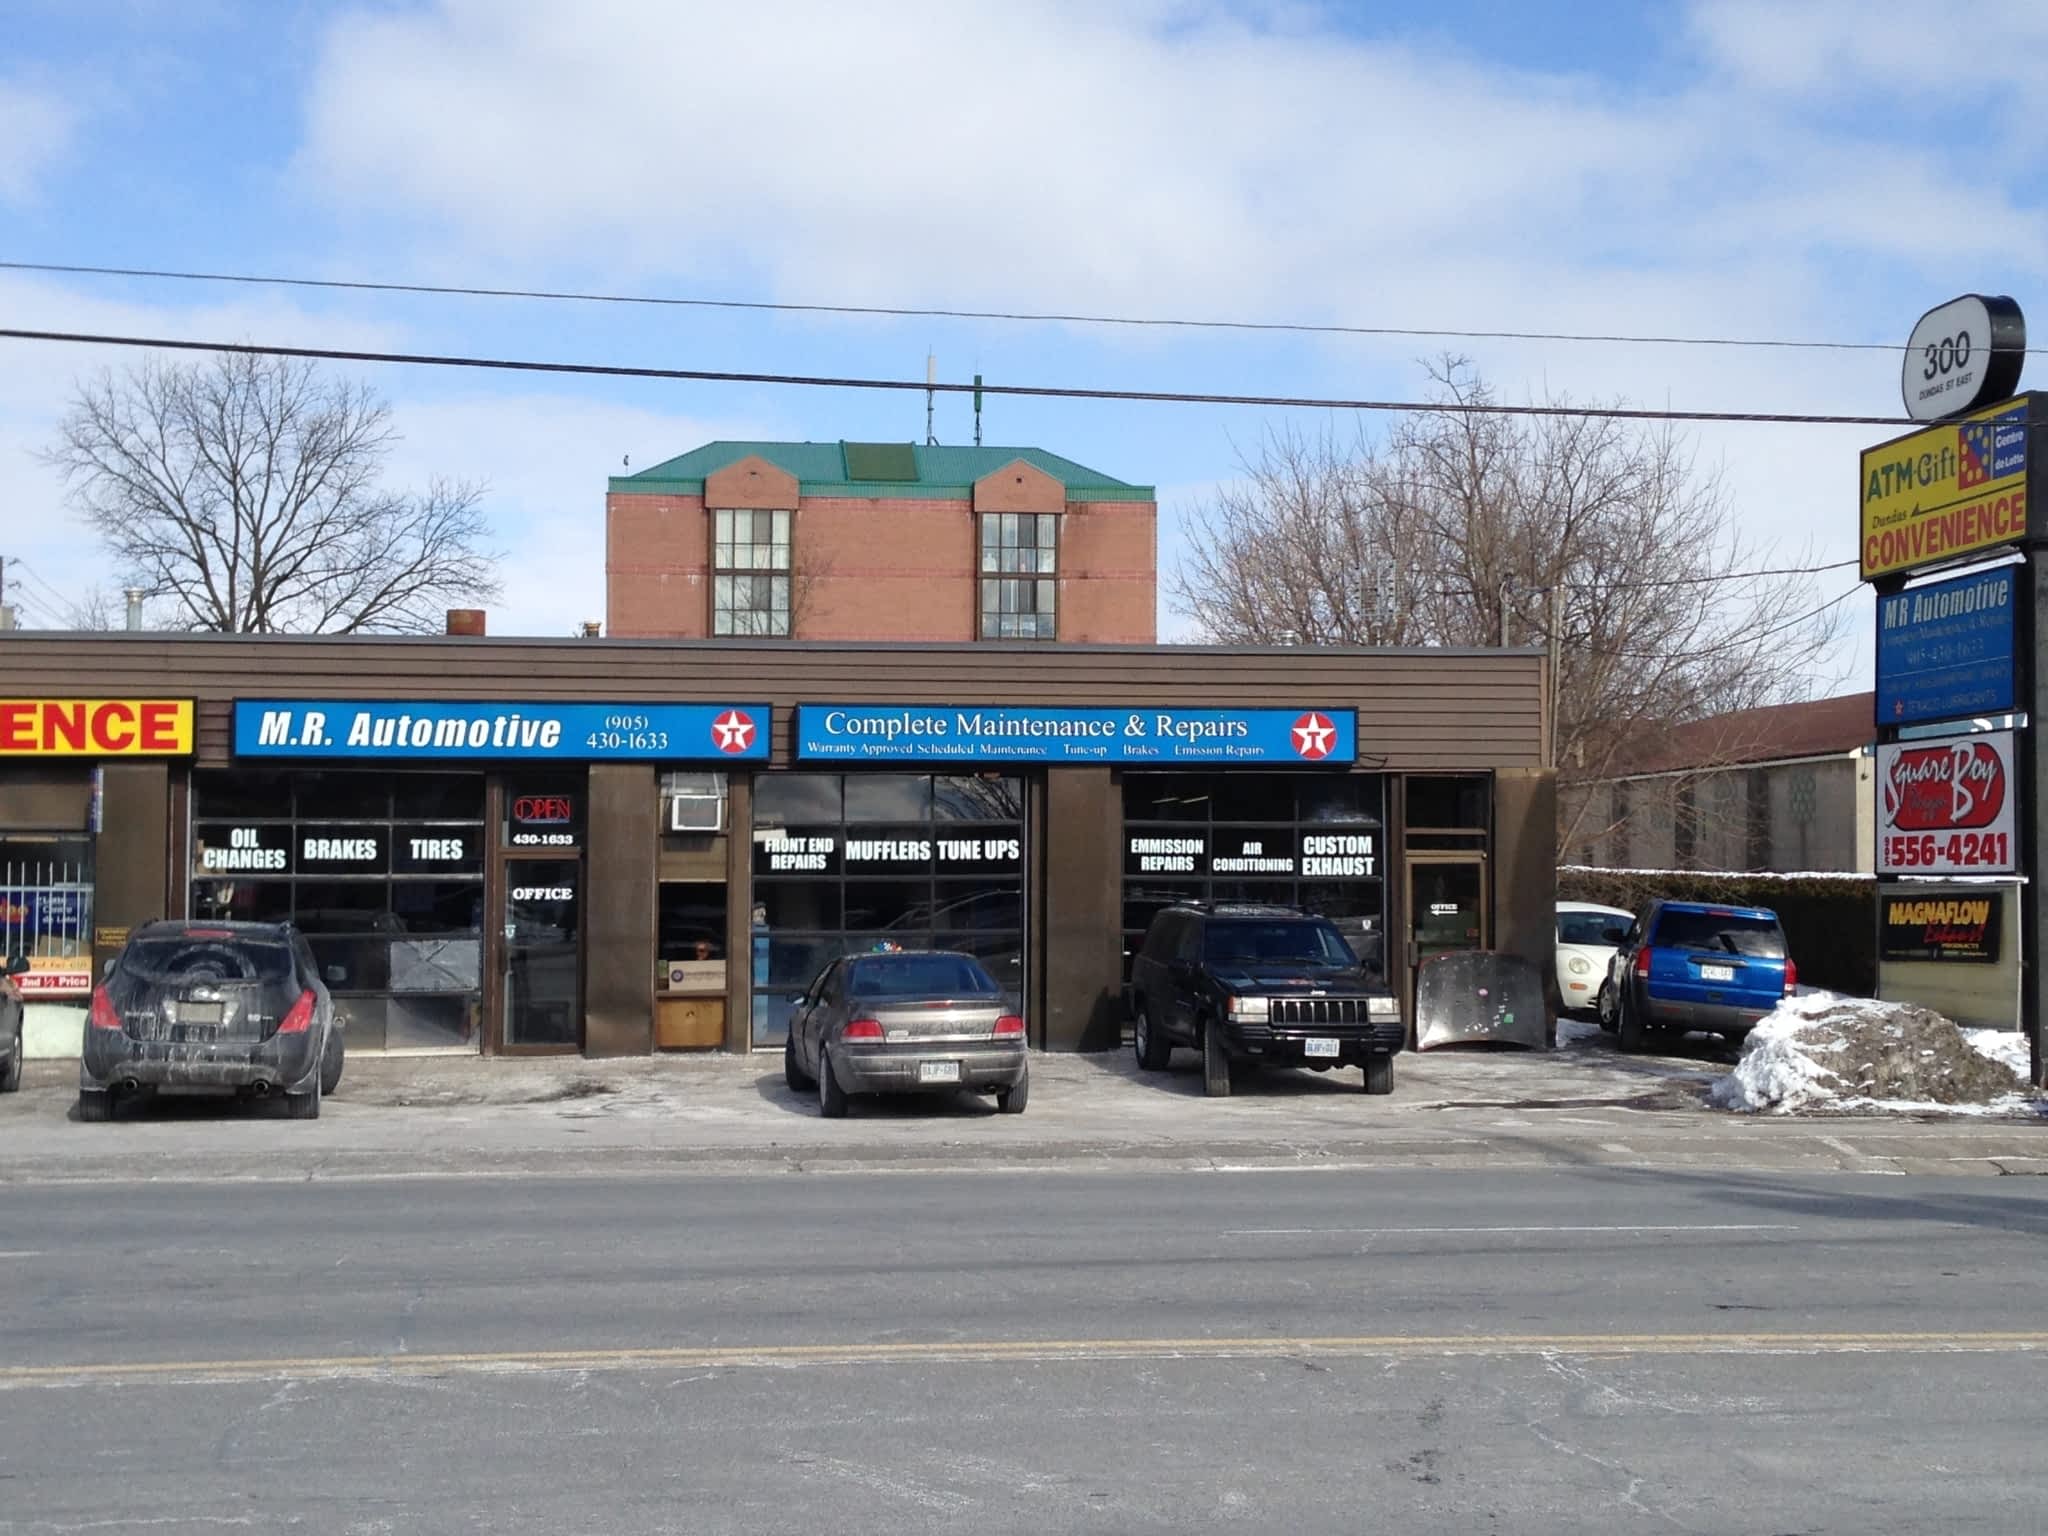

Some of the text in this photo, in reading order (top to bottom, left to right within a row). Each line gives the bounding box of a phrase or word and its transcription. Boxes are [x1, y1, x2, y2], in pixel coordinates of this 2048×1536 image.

[1924, 330, 1970, 380] 300
[1919, 372, 1973, 401] DUNDAS ST EAST
[1872, 509, 1908, 529] Dundas
[1864, 491, 2026, 571] CONVENIENCE
[1913, 579, 2008, 623] Automotive
[0, 703, 179, 750] ENCE
[258, 711, 562, 748] M.R. Automotive
[604, 715, 649, 730] (905)
[825, 711, 1249, 742] Complete Maintenance & Repairs
[586, 732, 669, 750] 430-1633
[807, 741, 1265, 757] Warranty Approved Scheduled Maintenance Tune-up Brakes Emission Repairs
[1884, 746, 1951, 828] Square
[1949, 740, 1998, 824] Boy
[514, 799, 571, 819] OPEN
[230, 828, 259, 848] OIL
[513, 833, 574, 845] 430-1633
[764, 837, 834, 853] FRONT END
[1131, 838, 1204, 854] EMMISSION
[1303, 836, 1373, 855] CUSTOM
[304, 838, 377, 860] BRAKES
[410, 839, 463, 860] TIRES
[845, 840, 931, 861] MUFFLERS
[937, 839, 1020, 860] TUNE UPS
[1242, 842, 1262, 855] AIR
[1891, 832, 2008, 867] 556-4241
[203, 849, 287, 869] CHANGES
[771, 854, 827, 870] REPAIRS
[1141, 856, 1195, 871] REPAIRS
[1212, 858, 1293, 872] CONDITIONING
[1302, 857, 1375, 876] EXHAUST
[512, 888, 573, 901] OFFICE
[1889, 900, 1990, 925] MAGNAFLOW
[58, 976, 87, 987] Price
